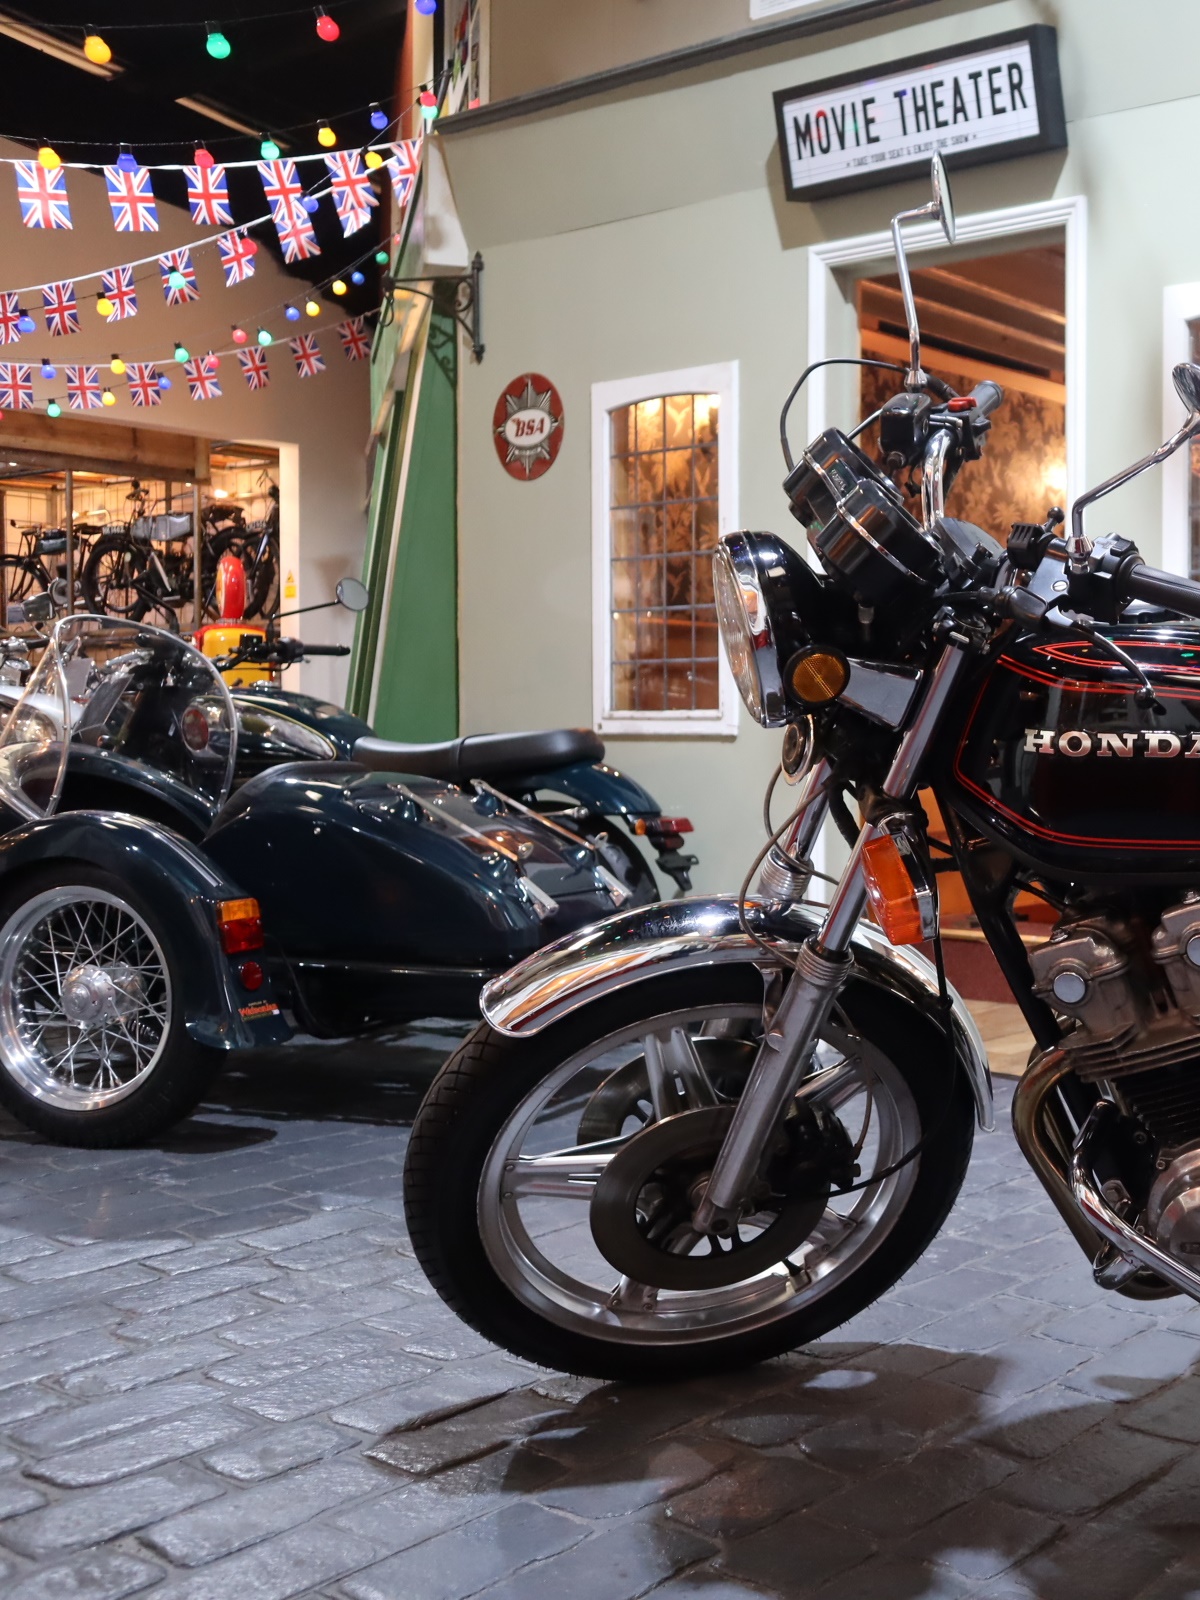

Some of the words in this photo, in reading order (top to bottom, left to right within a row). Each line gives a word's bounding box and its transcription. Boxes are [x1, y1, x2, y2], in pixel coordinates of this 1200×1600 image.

[794, 97, 880, 161] MOVIE
[893, 61, 1028, 137] THEATER
[852, 155, 868, 167] TAKE
[871, 151, 886, 163] YOUR
[888, 147, 904, 160] SEAT
[913, 141, 933, 154] ENJOY
[936, 137, 948, 148] THE
[951, 134, 969, 146] SHOW
[512, 417, 545, 437] BSA
